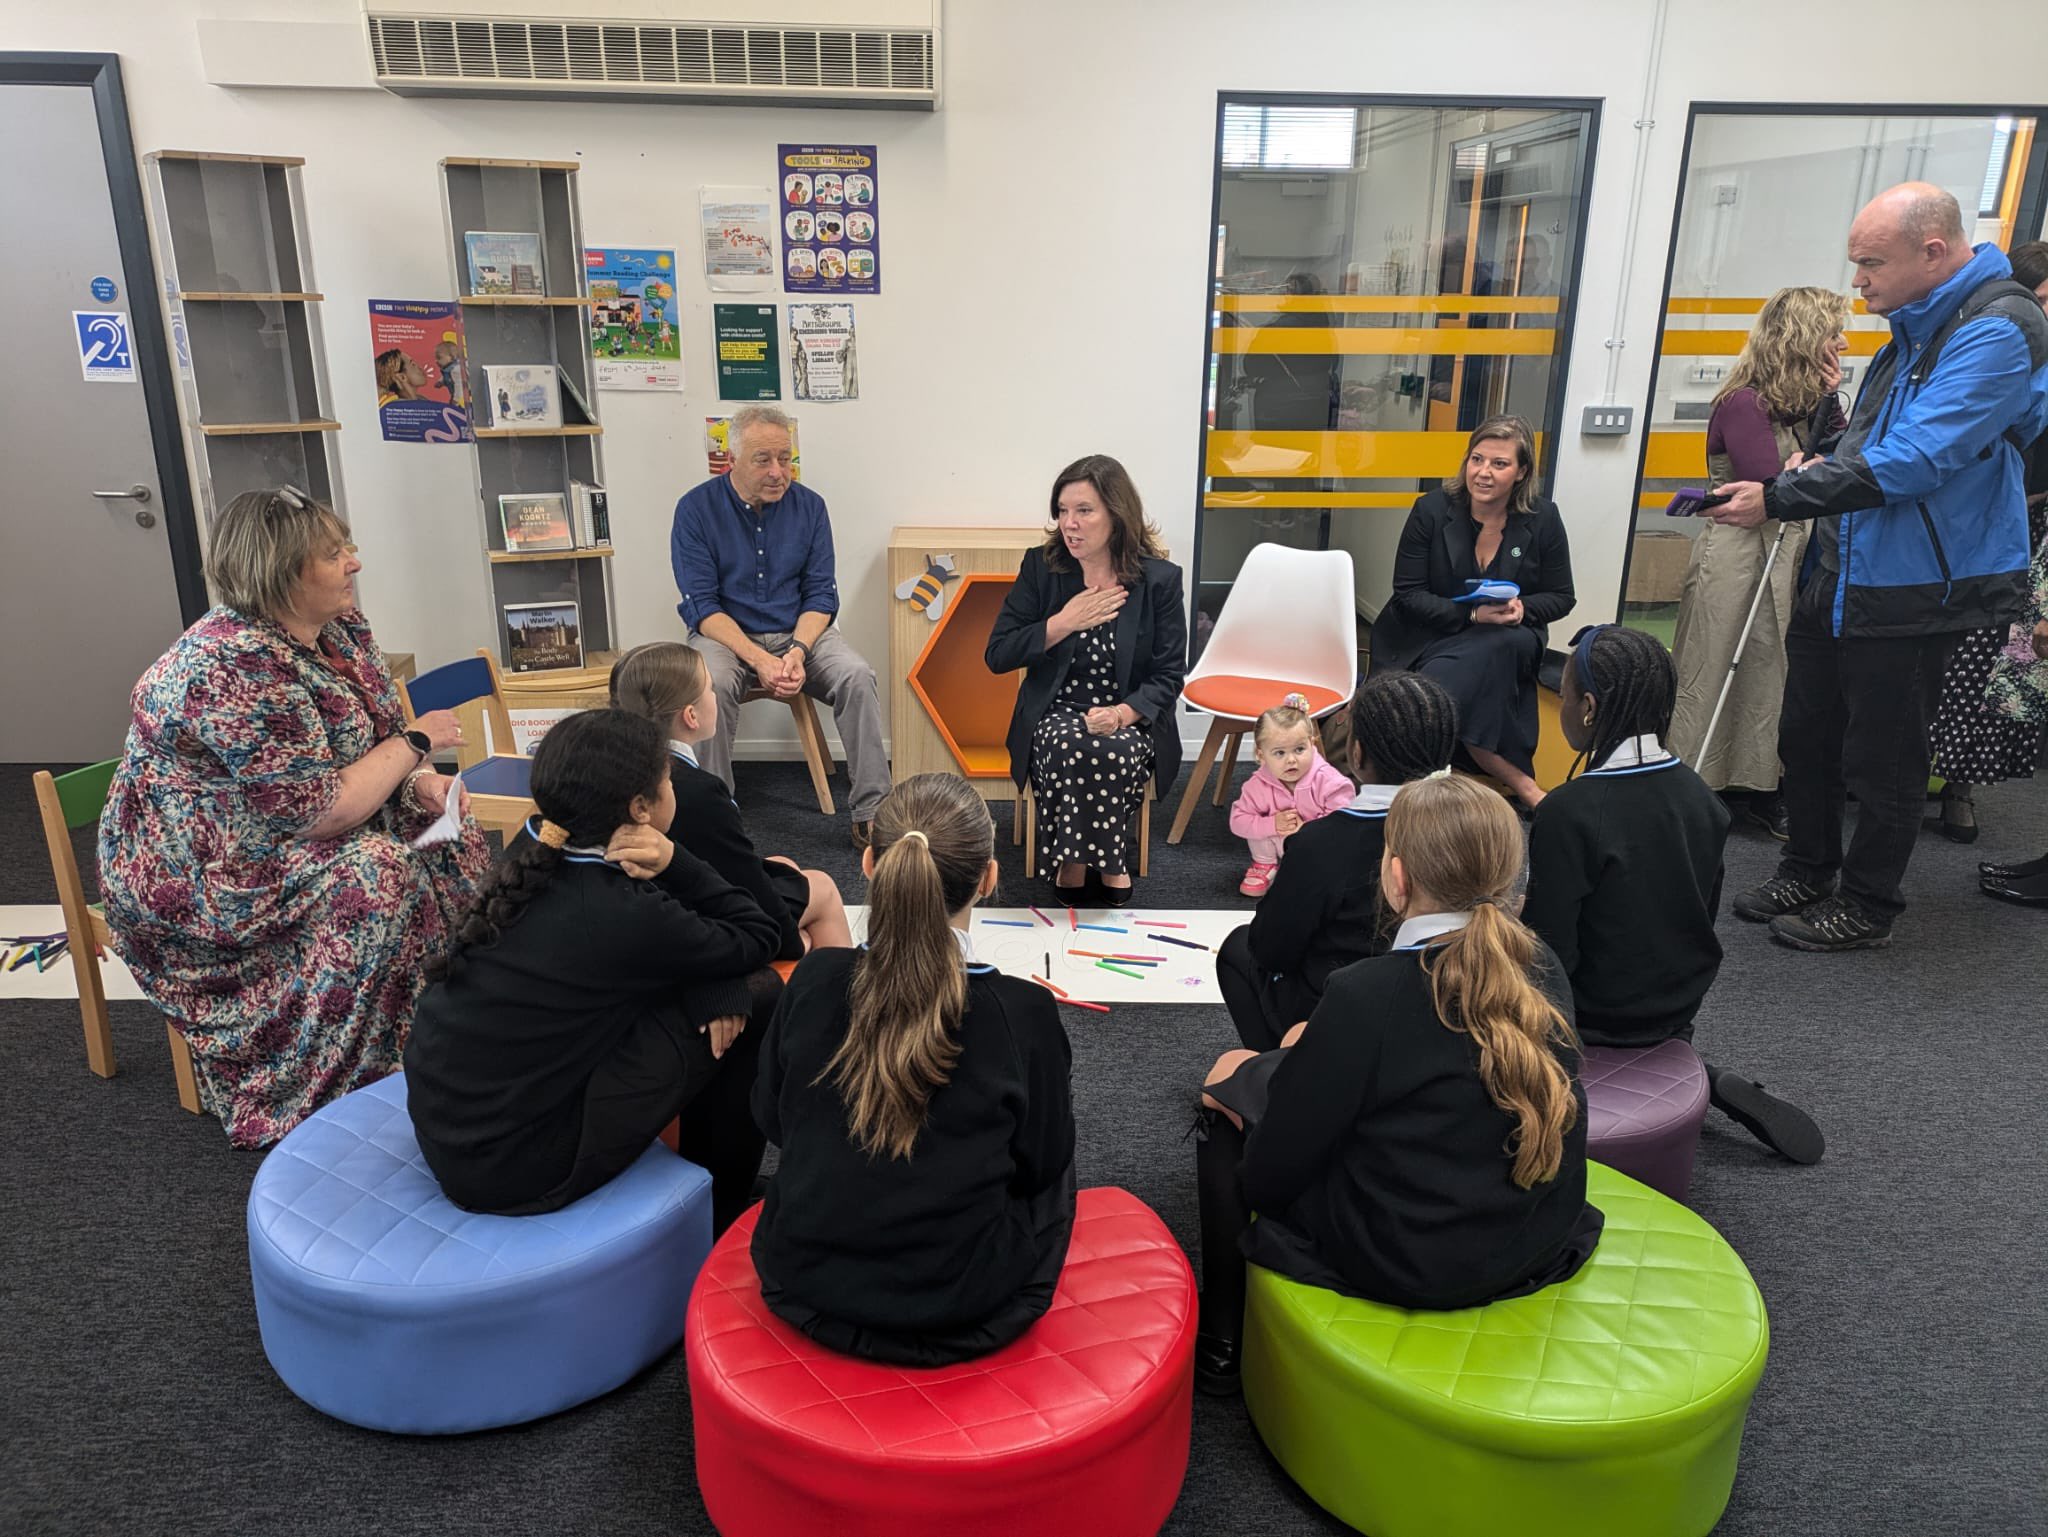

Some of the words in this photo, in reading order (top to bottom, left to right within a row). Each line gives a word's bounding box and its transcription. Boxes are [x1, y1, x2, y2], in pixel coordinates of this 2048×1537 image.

[790, 156, 820, 165] TOOLS
[834, 156, 865, 165] TALKING
[613, 270, 638, 278] Reading
[640, 270, 671, 278] Challenge
[405, 304, 429, 314] happy
[116, 352, 128, 366] T
[596, 494, 604, 504] B
[522, 506, 545, 514] DEAN
[519, 513, 551, 521] KOONTZ
[528, 719, 556, 727] BOOKS
